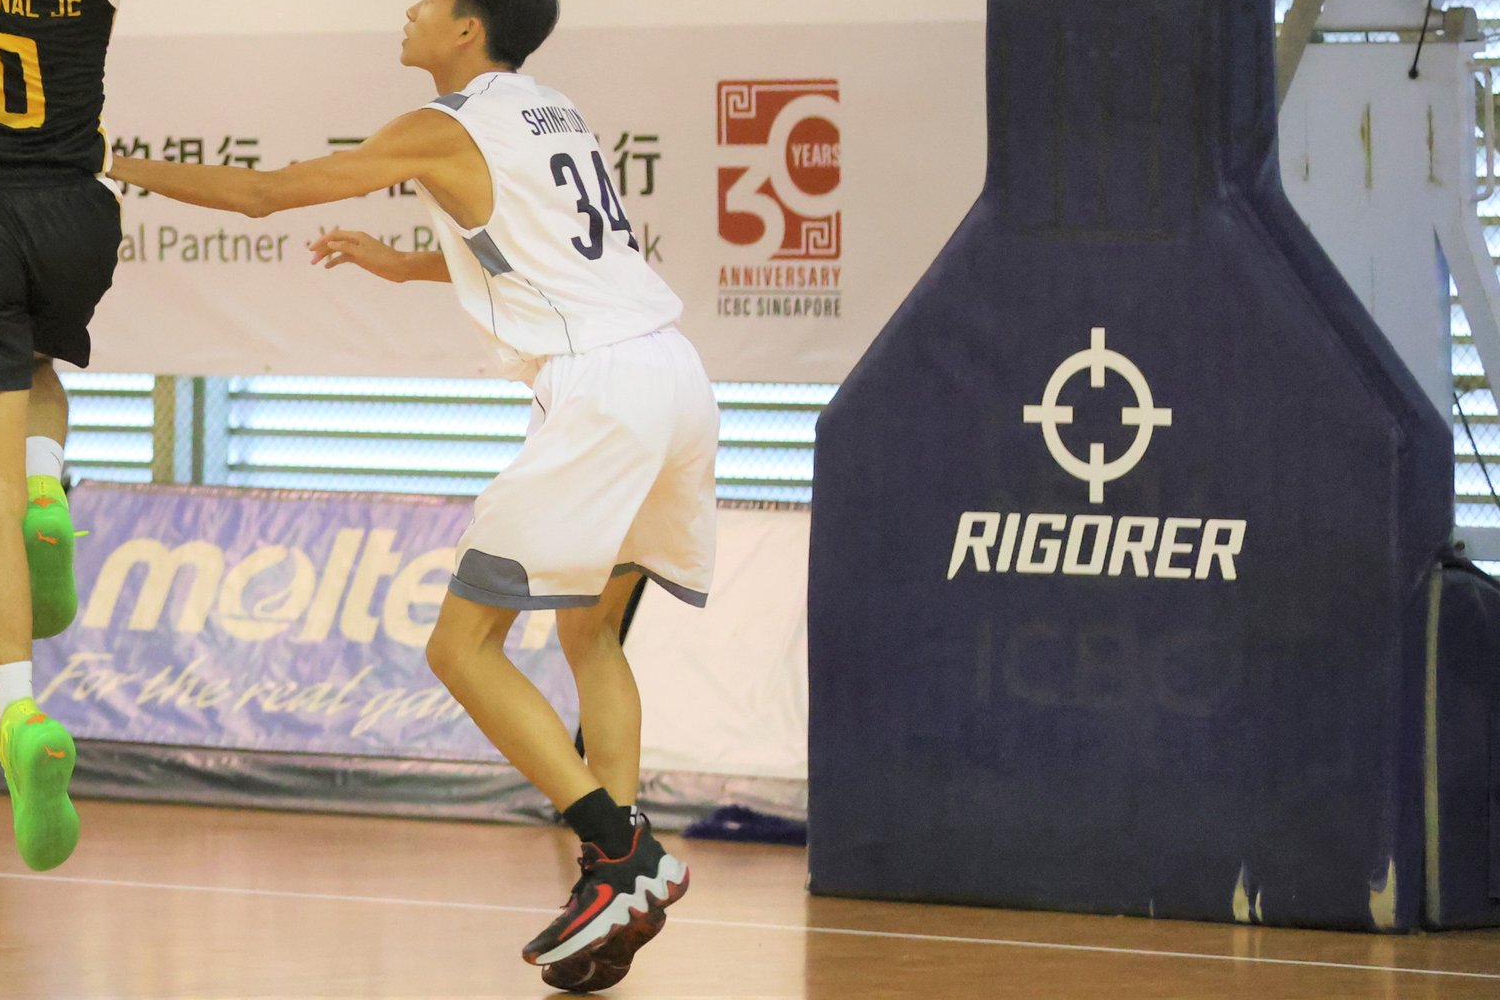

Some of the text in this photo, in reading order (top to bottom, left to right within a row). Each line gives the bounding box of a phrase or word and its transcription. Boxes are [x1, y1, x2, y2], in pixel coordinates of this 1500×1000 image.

[792, 143, 841, 169] YEARS
[549, 150, 640, 261] 34
[159, 224, 289, 264] Partner
[718, 265, 842, 288] ANNIVERSARY
[717, 297, 842, 318] ICBC SINGAPORE
[947, 511, 1247, 581] RIGORER
[36, 652, 146, 705] For
[135, 654, 234, 710] the
[231, 664, 375, 715] real
